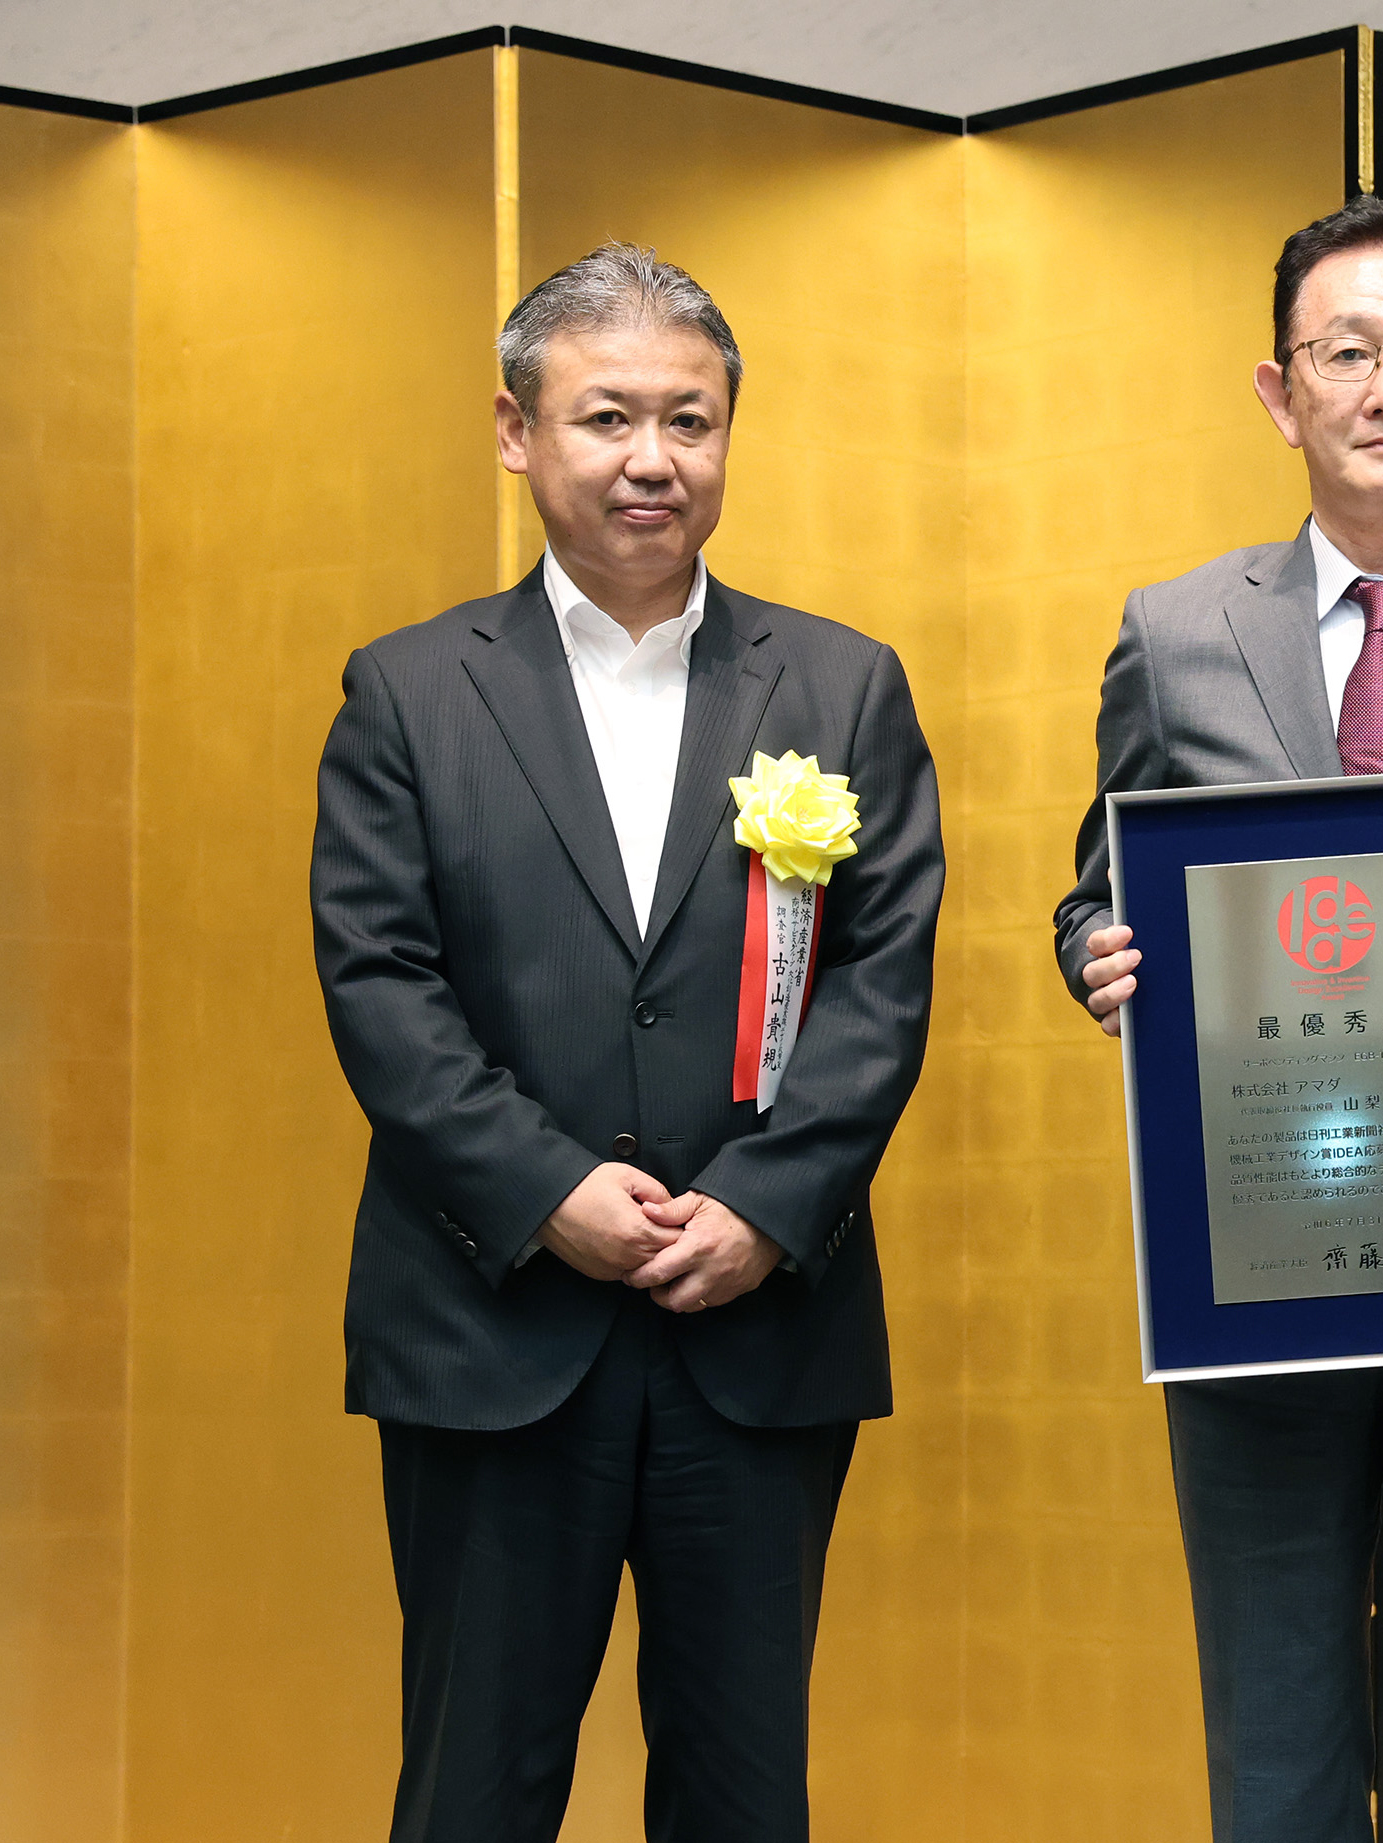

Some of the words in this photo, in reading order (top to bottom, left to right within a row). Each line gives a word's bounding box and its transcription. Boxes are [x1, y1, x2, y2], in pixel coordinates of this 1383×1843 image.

[794, 888, 814, 987] 経済産業省
[762, 952, 789, 1070] 古山貴規
[1231, 1081, 1289, 1099] 株式会社
[1295, 1078, 1342, 1094] アマダ
